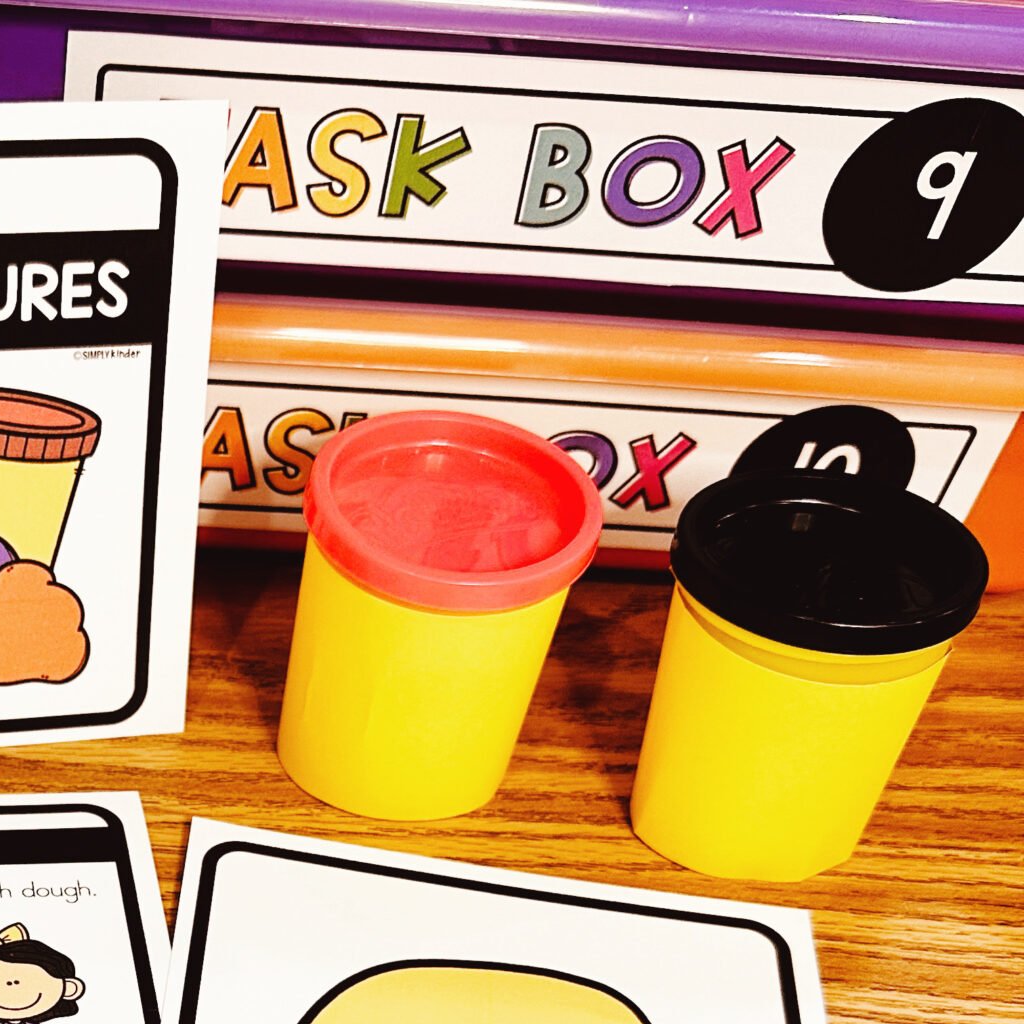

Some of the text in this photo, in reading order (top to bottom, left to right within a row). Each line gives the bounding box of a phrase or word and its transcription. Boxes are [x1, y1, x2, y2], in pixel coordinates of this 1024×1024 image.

[222, 106, 796, 241] ASK BOX
[916, 149, 978, 241] 9
[200, 405, 369, 496] AS
[21, 879, 97, 904] dough.
